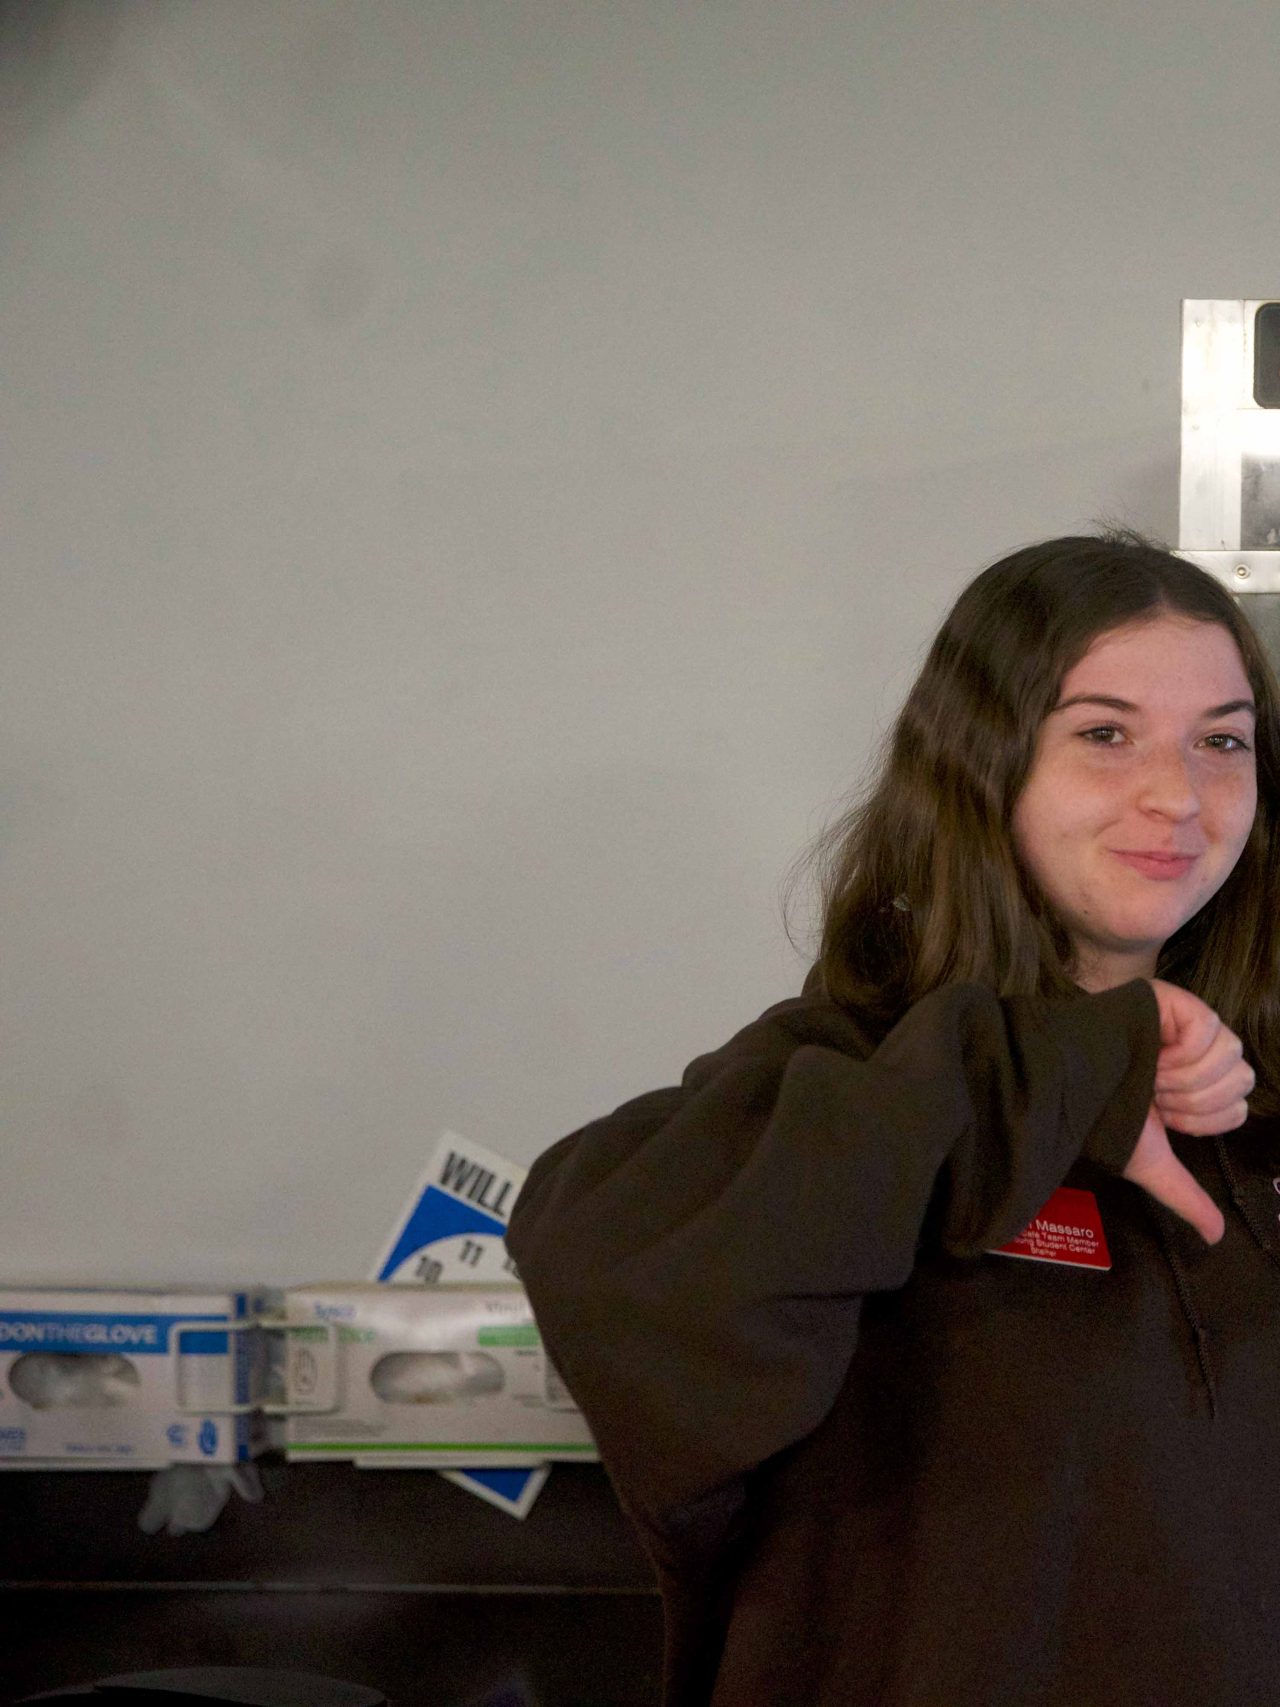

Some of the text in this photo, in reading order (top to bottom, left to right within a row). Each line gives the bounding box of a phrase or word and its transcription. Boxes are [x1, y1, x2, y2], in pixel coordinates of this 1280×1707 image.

[439, 1151, 512, 1217] WILL
[1035, 1219, 1094, 1239] Massaro
[459, 1240, 484, 1268] 11
